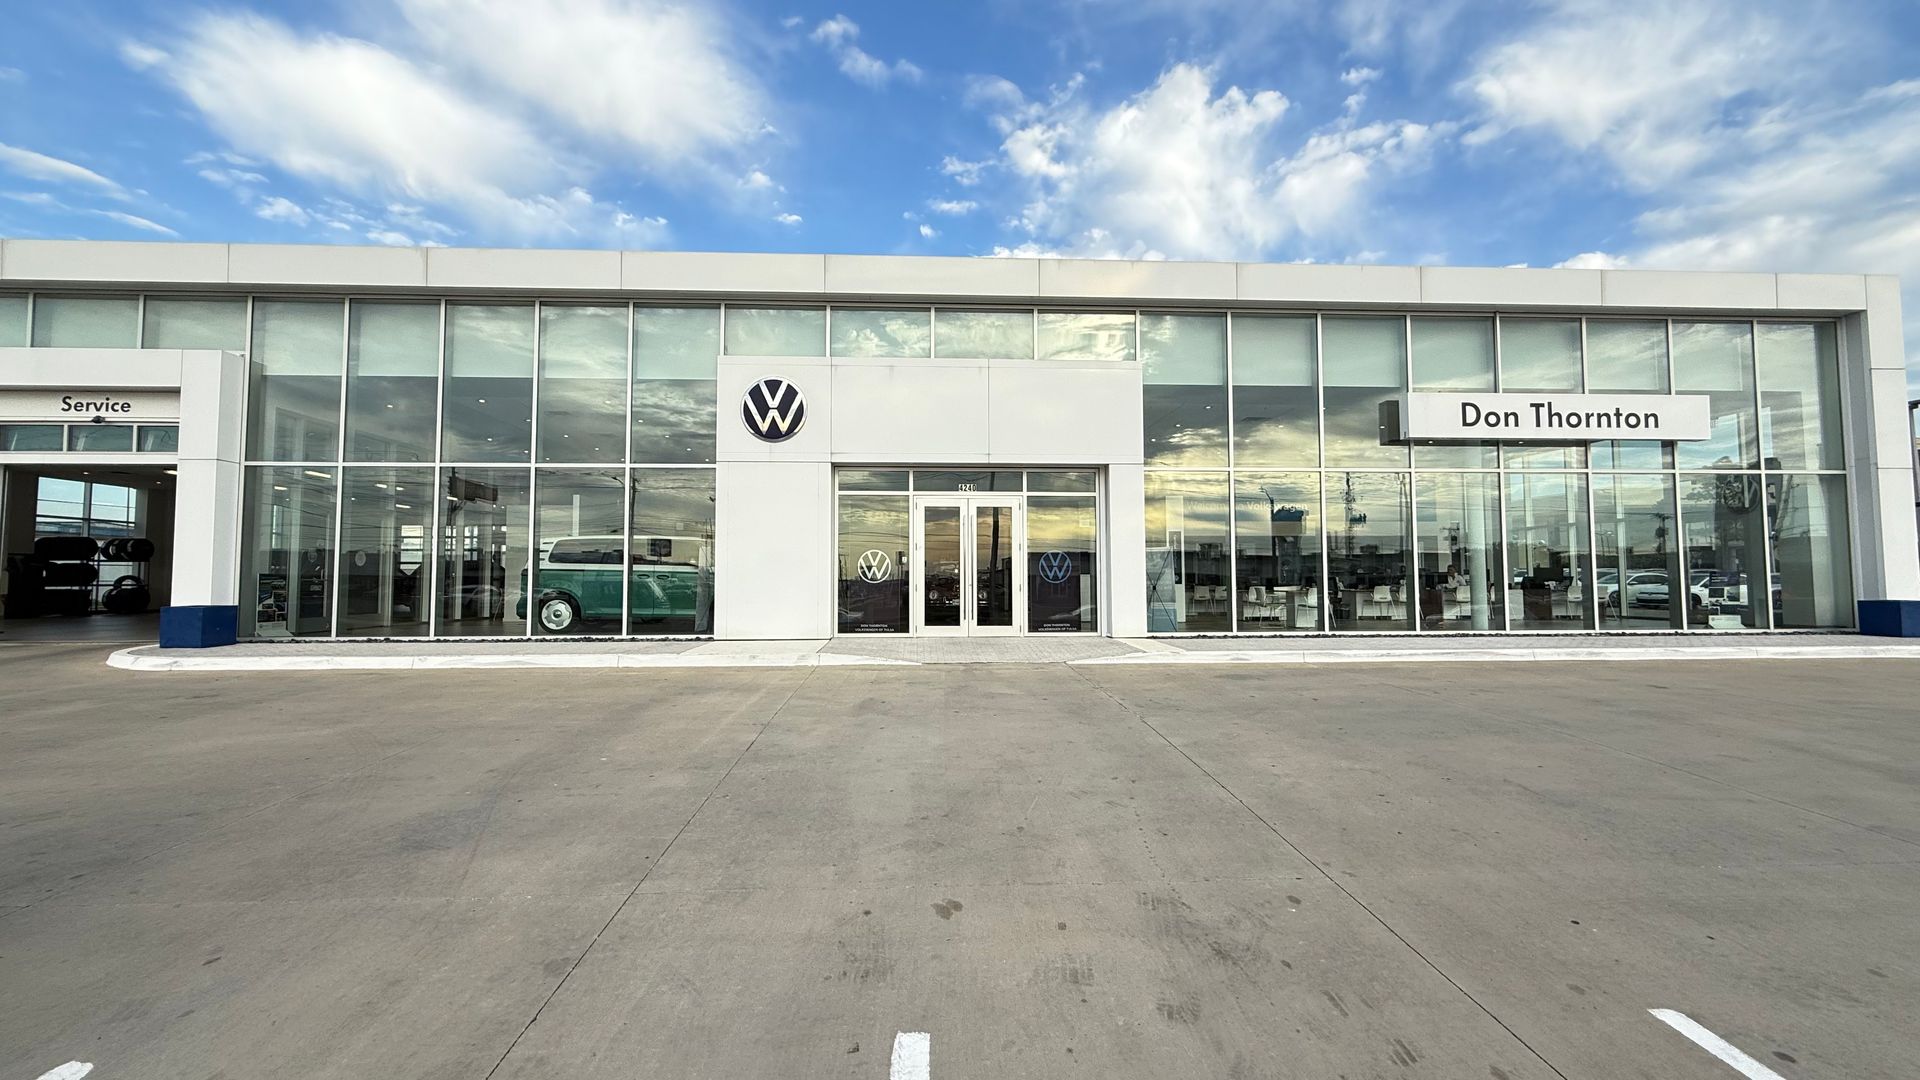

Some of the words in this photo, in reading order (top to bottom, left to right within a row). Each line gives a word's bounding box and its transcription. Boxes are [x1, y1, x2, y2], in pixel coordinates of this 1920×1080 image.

[61, 395, 132, 412] Service
[1461, 401, 1519, 428] Don
[1529, 401, 1660, 429] Thornton
[959, 484, 977, 492] 4240
